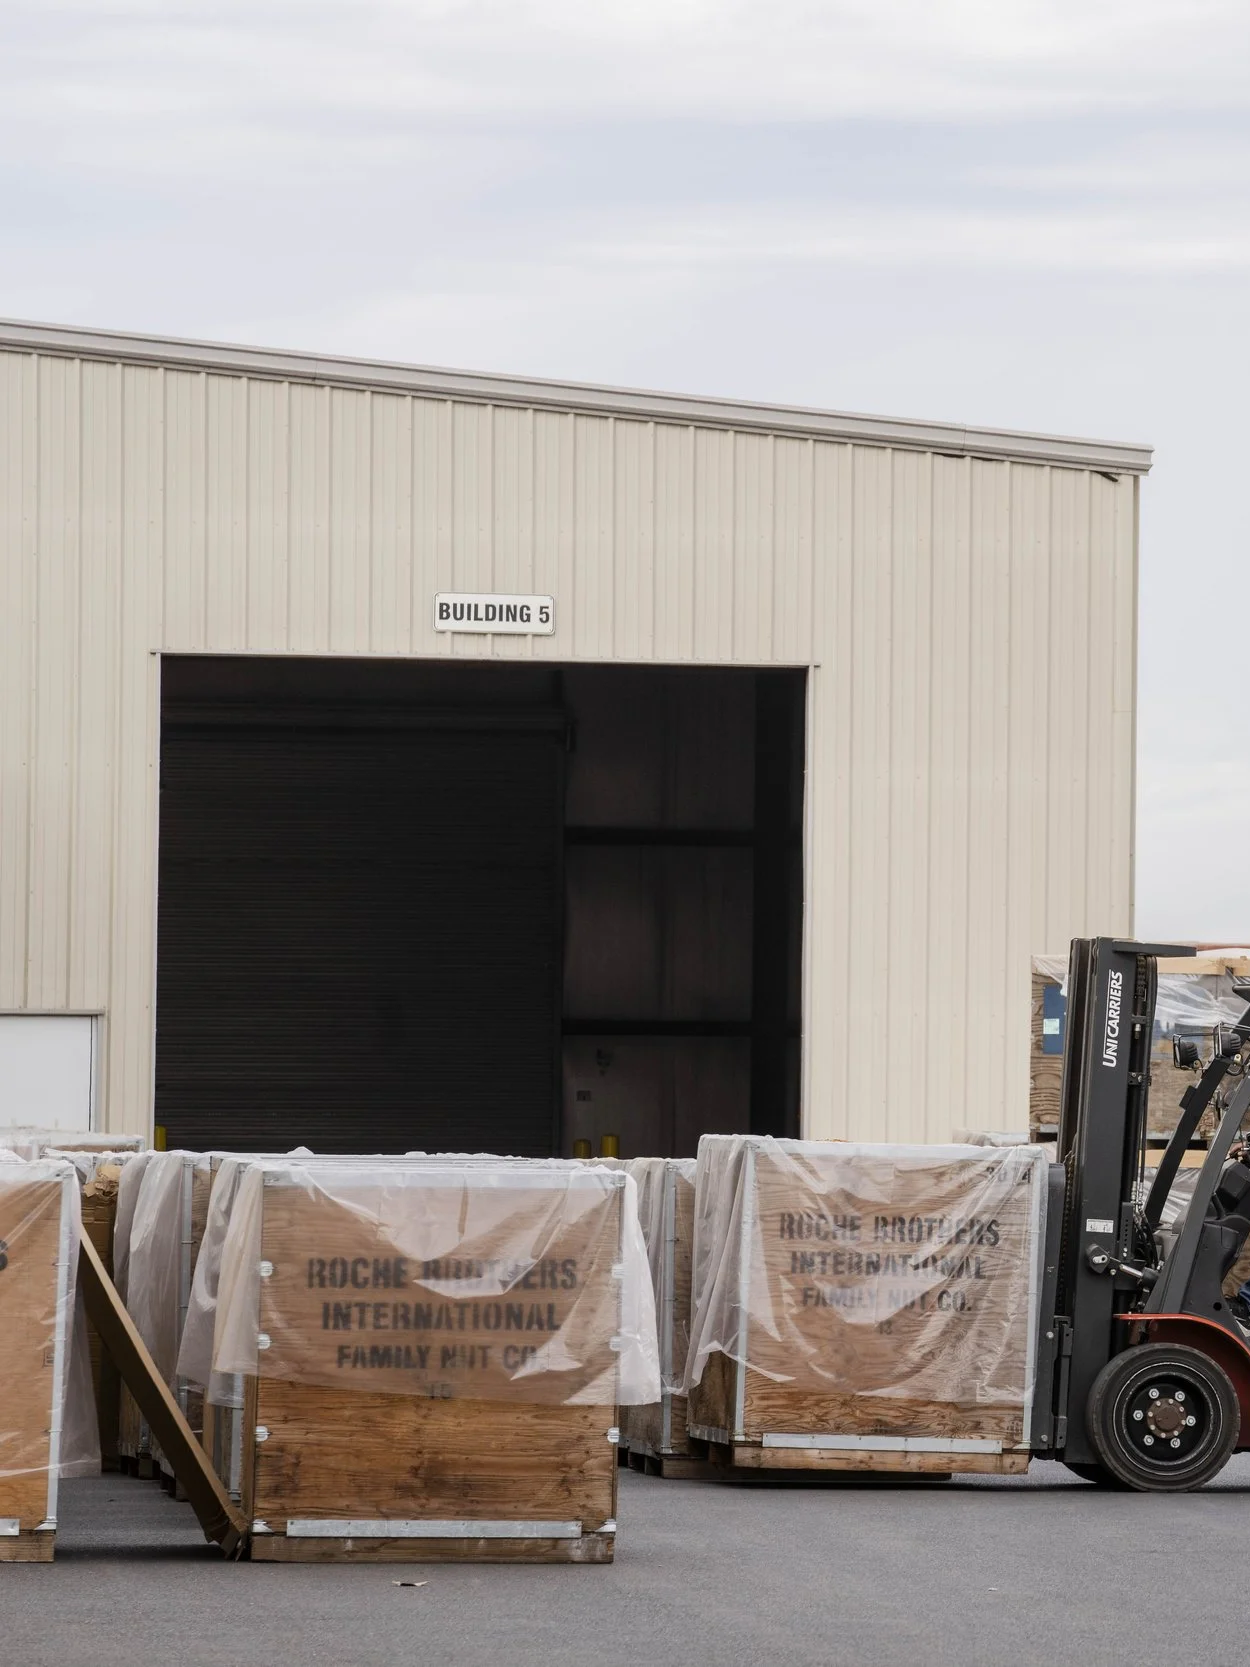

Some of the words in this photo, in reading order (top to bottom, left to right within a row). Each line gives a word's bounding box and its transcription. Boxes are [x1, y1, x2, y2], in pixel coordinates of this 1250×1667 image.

[438, 602, 531, 623] BUILDING
[539, 606, 551, 624] 5
[1102, 969, 1123, 1068] UNICARRIERS
[779, 1212, 862, 1242] ROCHE
[307, 1256, 409, 1289] ROCHE
[790, 1250, 987, 1281] INTERNATIONAL
[801, 1286, 878, 1310] FAMILY
[887, 1288, 931, 1312] NUT
[321, 1301, 562, 1332] INTERNATIONAL
[336, 1344, 432, 1369] FAMILY
[440, 1344, 493, 1369] NUT
